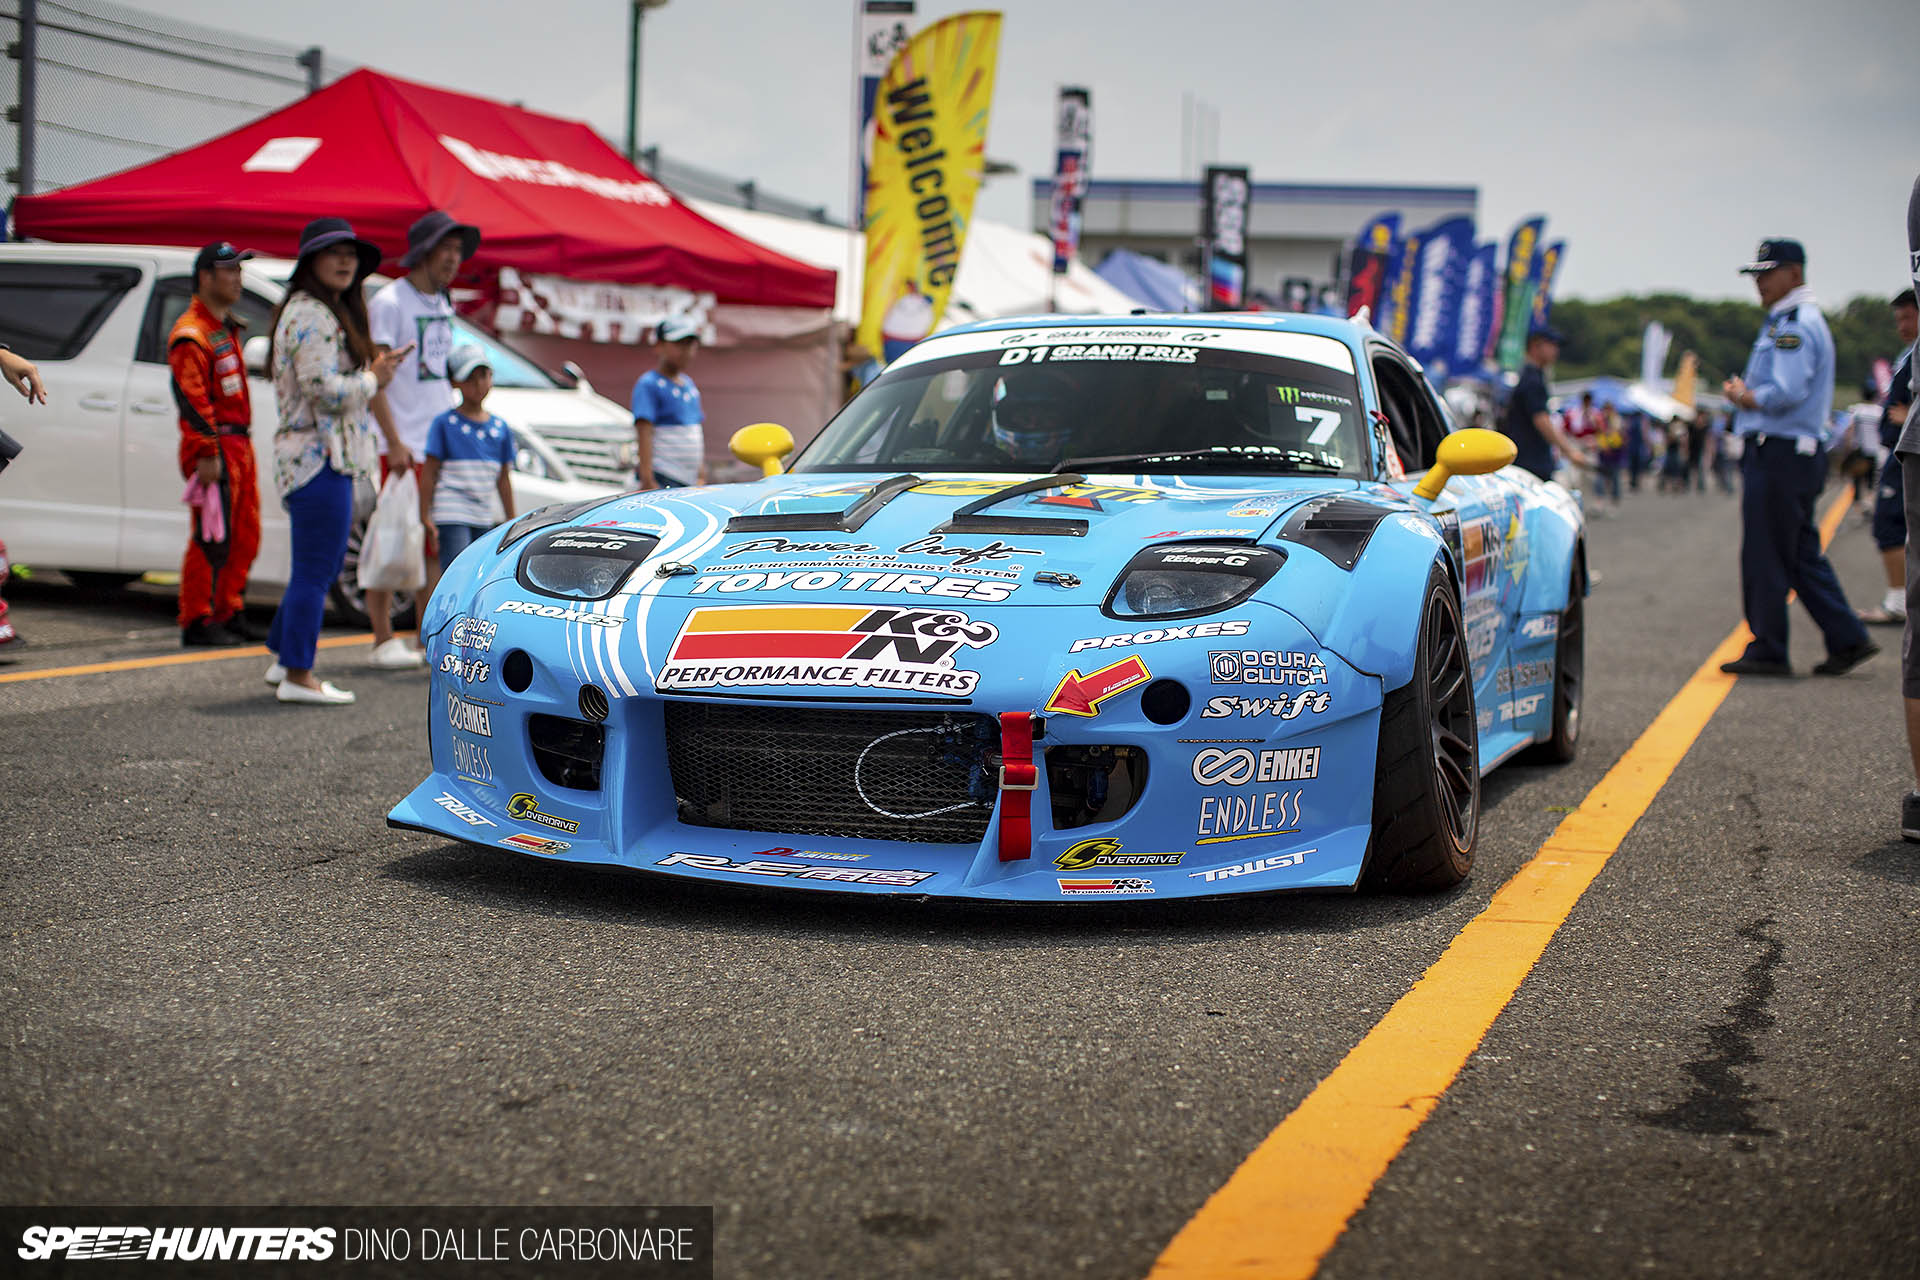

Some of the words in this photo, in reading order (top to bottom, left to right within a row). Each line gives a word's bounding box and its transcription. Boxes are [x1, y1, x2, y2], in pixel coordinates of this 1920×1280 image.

[886, 77, 959, 288] Welcome
[999, 346, 1050, 366] D1
[1051, 344, 1137, 358] GRAND
[1138, 345, 1200, 360] PRIX
[1294, 406, 1342, 446] 7
[721, 537, 880, 558] Power
[898, 535, 1044, 566] Craft
[833, 554, 898, 562] JAPAN
[748, 561, 865, 571] PERFORMANCE
[869, 561, 947, 573] EXHAUST
[950, 567, 1019, 579] SYSTEM
[689, 570, 841, 596] TOYO
[840, 572, 1021, 602] TIRES
[495, 601, 629, 628] PROXES
[1069, 620, 1251, 653] PROXES
[1242, 650, 1326, 670] OGURA
[662, 665, 858, 684] PERFORMANCE
[863, 667, 973, 690] FILTERS
[1243, 667, 1328, 685] CLUTCH
[461, 700, 493, 738] ENKEI
[1201, 690, 1331, 720] Swift
[452, 735, 493, 781] ENDLESS
[1256, 746, 1321, 783] ENKEI
[432, 791, 498, 827] TRUST
[525, 809, 576, 833] OVERDRIVE
[1197, 788, 1303, 836] ENDLESS
[1096, 854, 1180, 866] OVERDRIVE
[1188, 848, 1318, 882] TRUST
